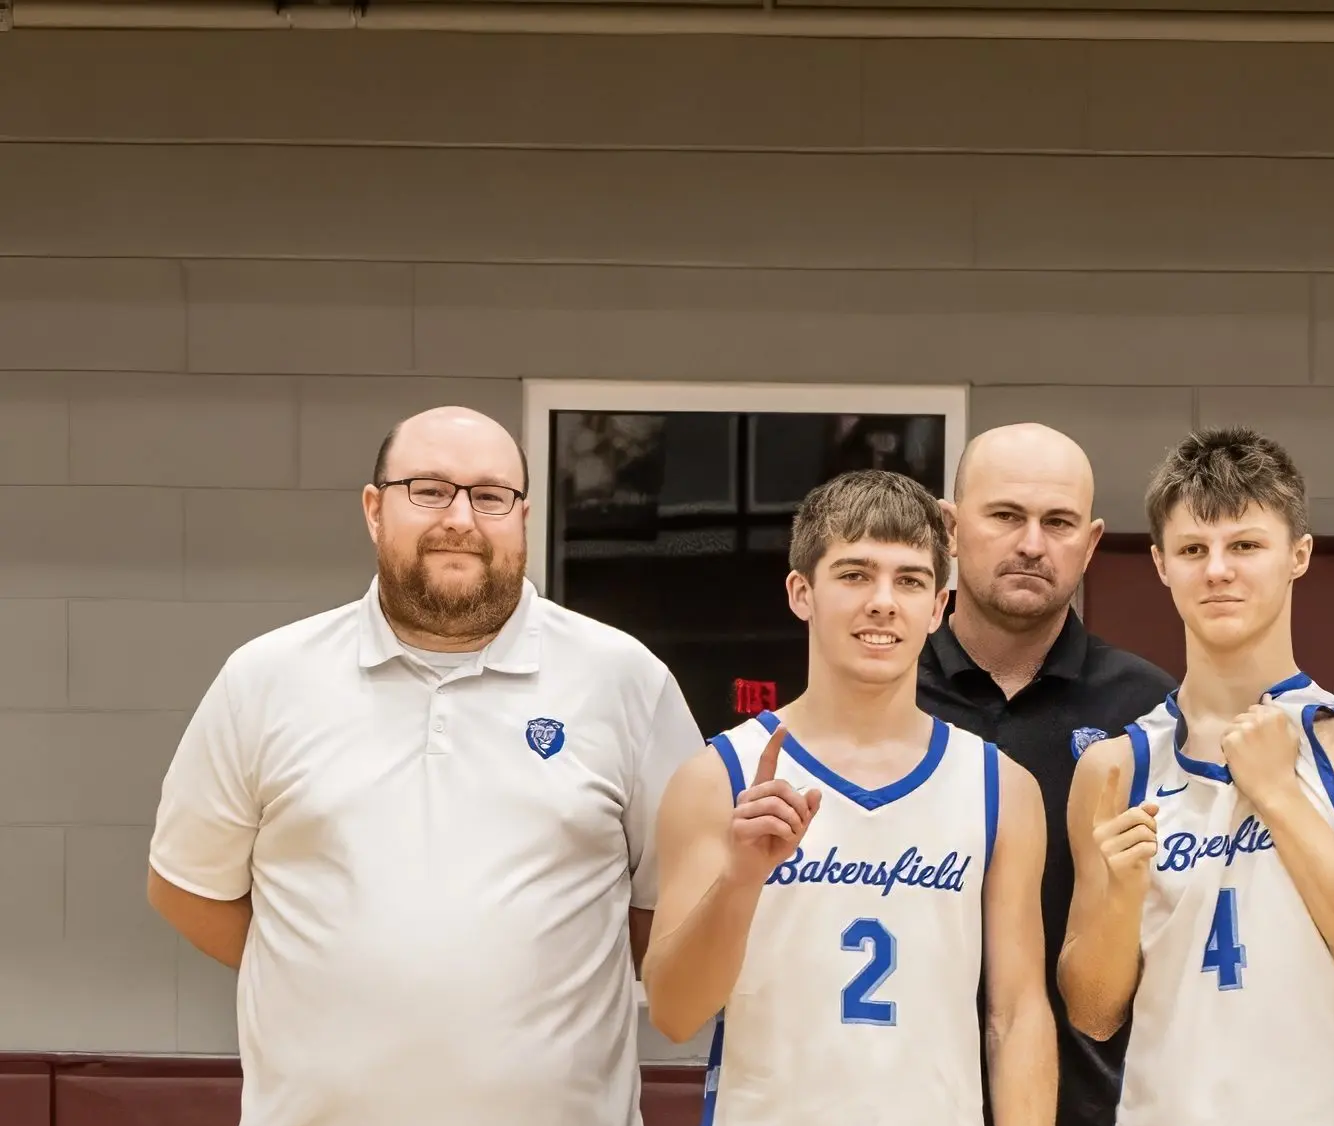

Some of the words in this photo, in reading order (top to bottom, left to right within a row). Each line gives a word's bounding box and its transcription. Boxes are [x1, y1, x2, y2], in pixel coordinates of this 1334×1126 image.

[764, 846, 972, 897] Bakersfield
[840, 917, 897, 1026] 2
[1200, 887, 1247, 991] 4
